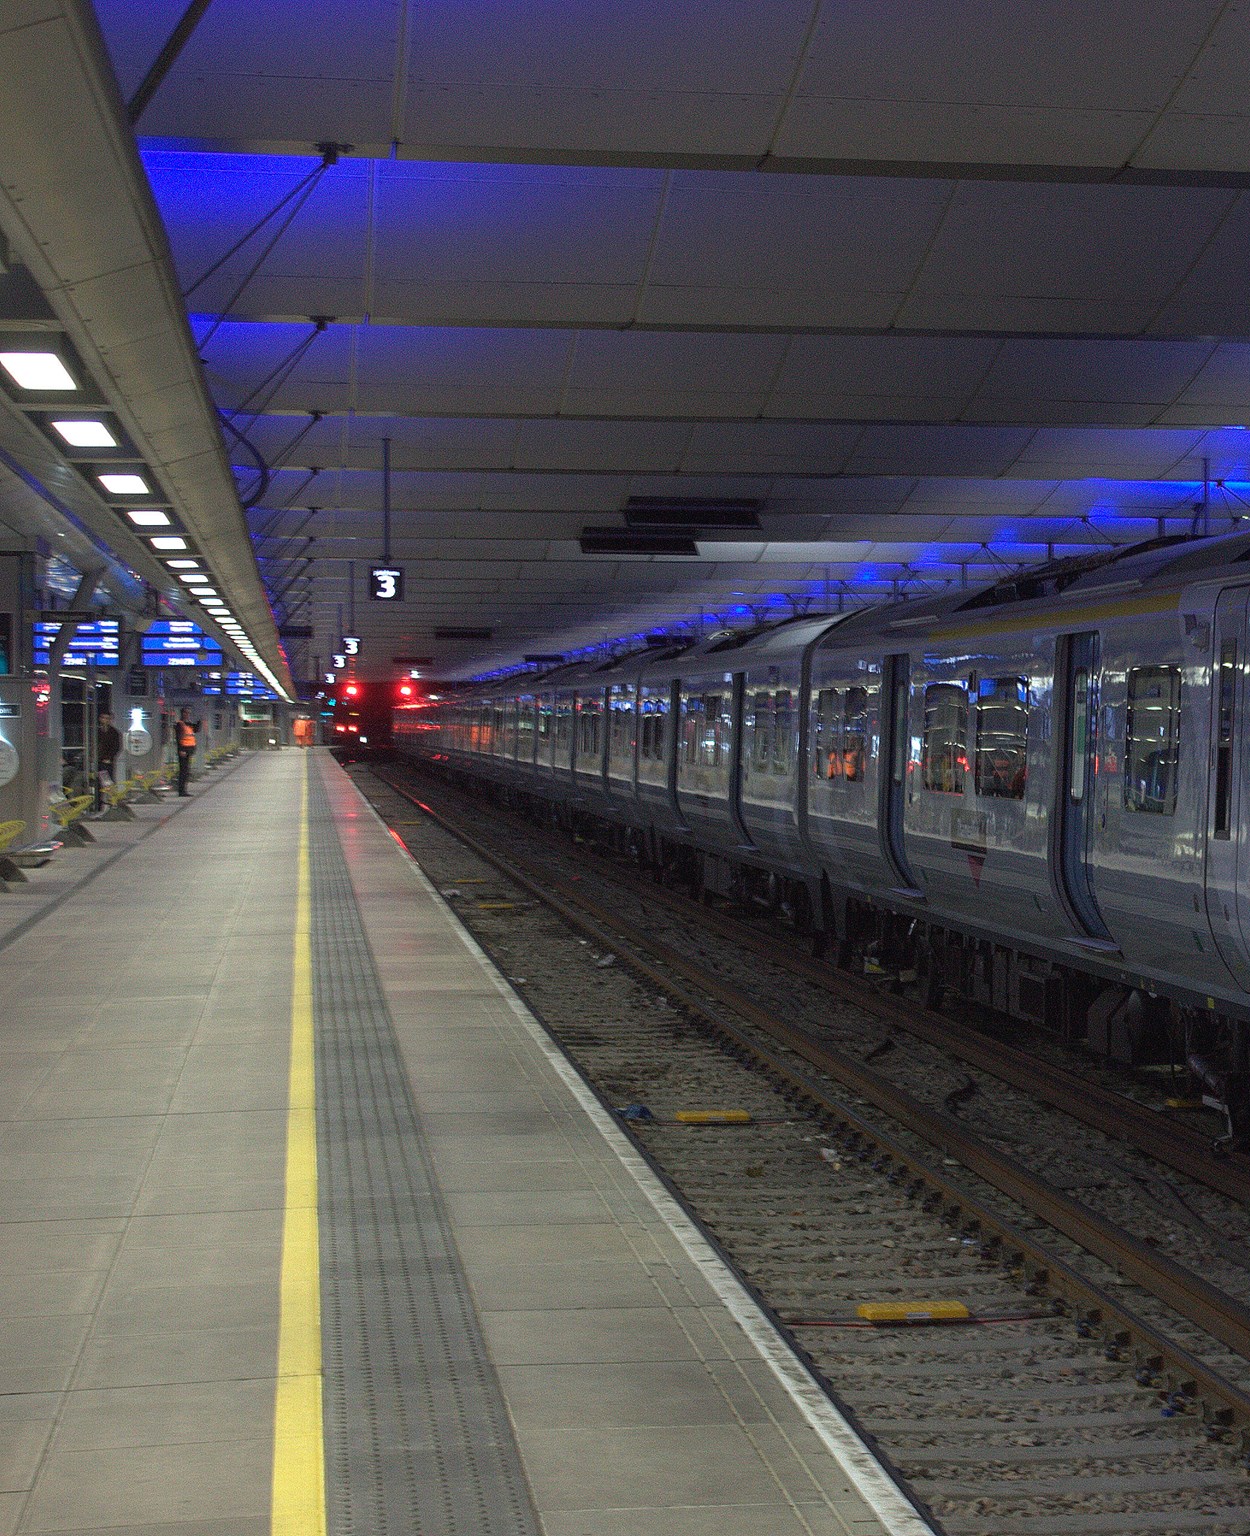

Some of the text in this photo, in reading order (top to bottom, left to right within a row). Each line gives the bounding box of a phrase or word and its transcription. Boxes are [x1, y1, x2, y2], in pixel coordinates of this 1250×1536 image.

[376, 575, 396, 598] 3
[344, 641, 359, 655] 3
[333, 657, 346, 669] 3
